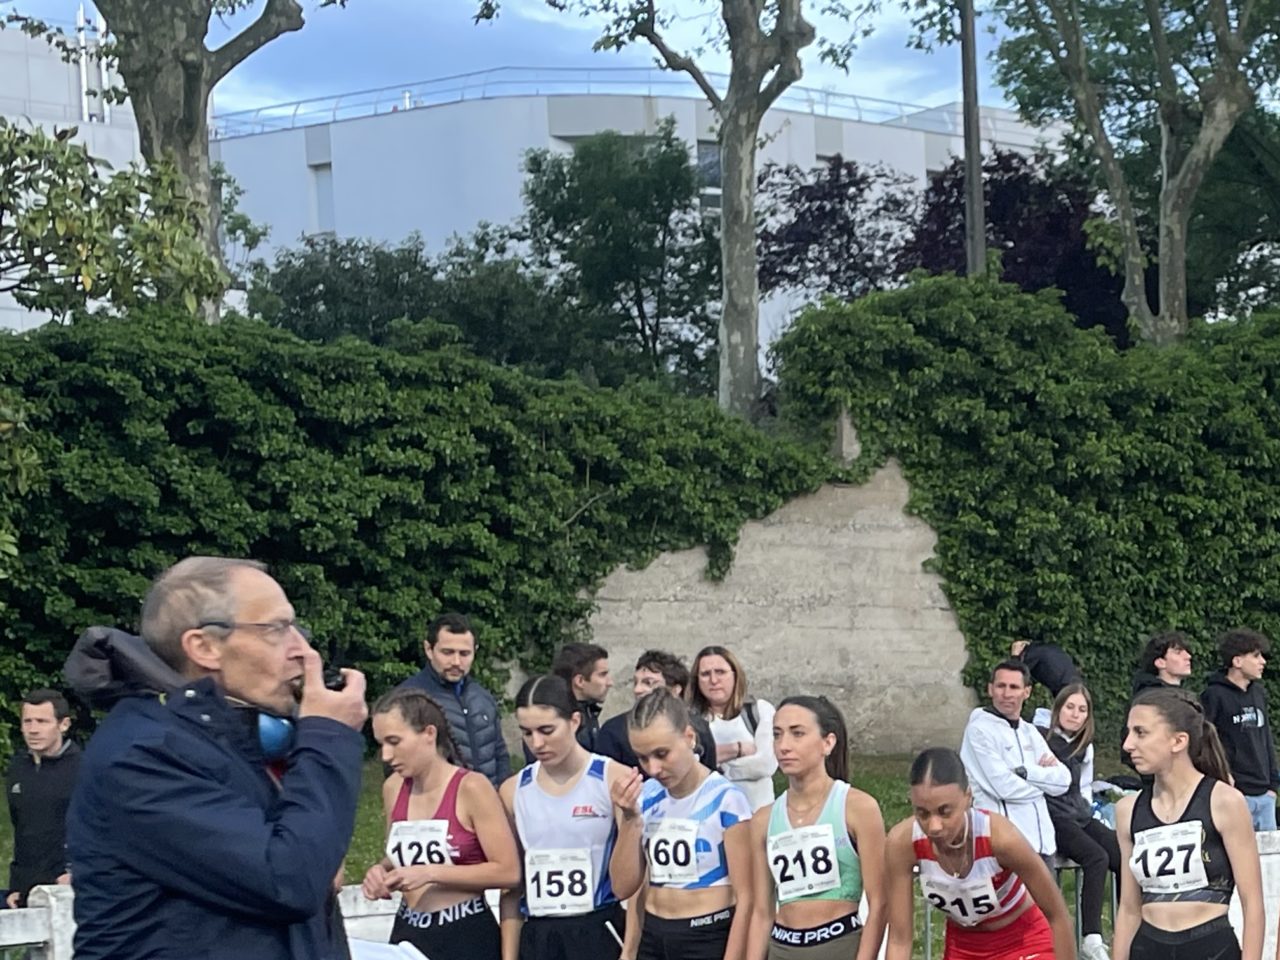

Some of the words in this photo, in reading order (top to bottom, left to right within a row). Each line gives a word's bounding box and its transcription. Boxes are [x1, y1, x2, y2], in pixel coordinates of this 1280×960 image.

[391, 840, 446, 867] 126
[773, 845, 832, 883] 218
[1135, 843, 1196, 878] 127
[531, 869, 587, 898] 158
[402, 906, 433, 929] PRO
[438, 897, 485, 925] NIKE
[928, 892, 995, 917] 215
[771, 926, 803, 944] NIKE
[804, 922, 844, 944] PRO
